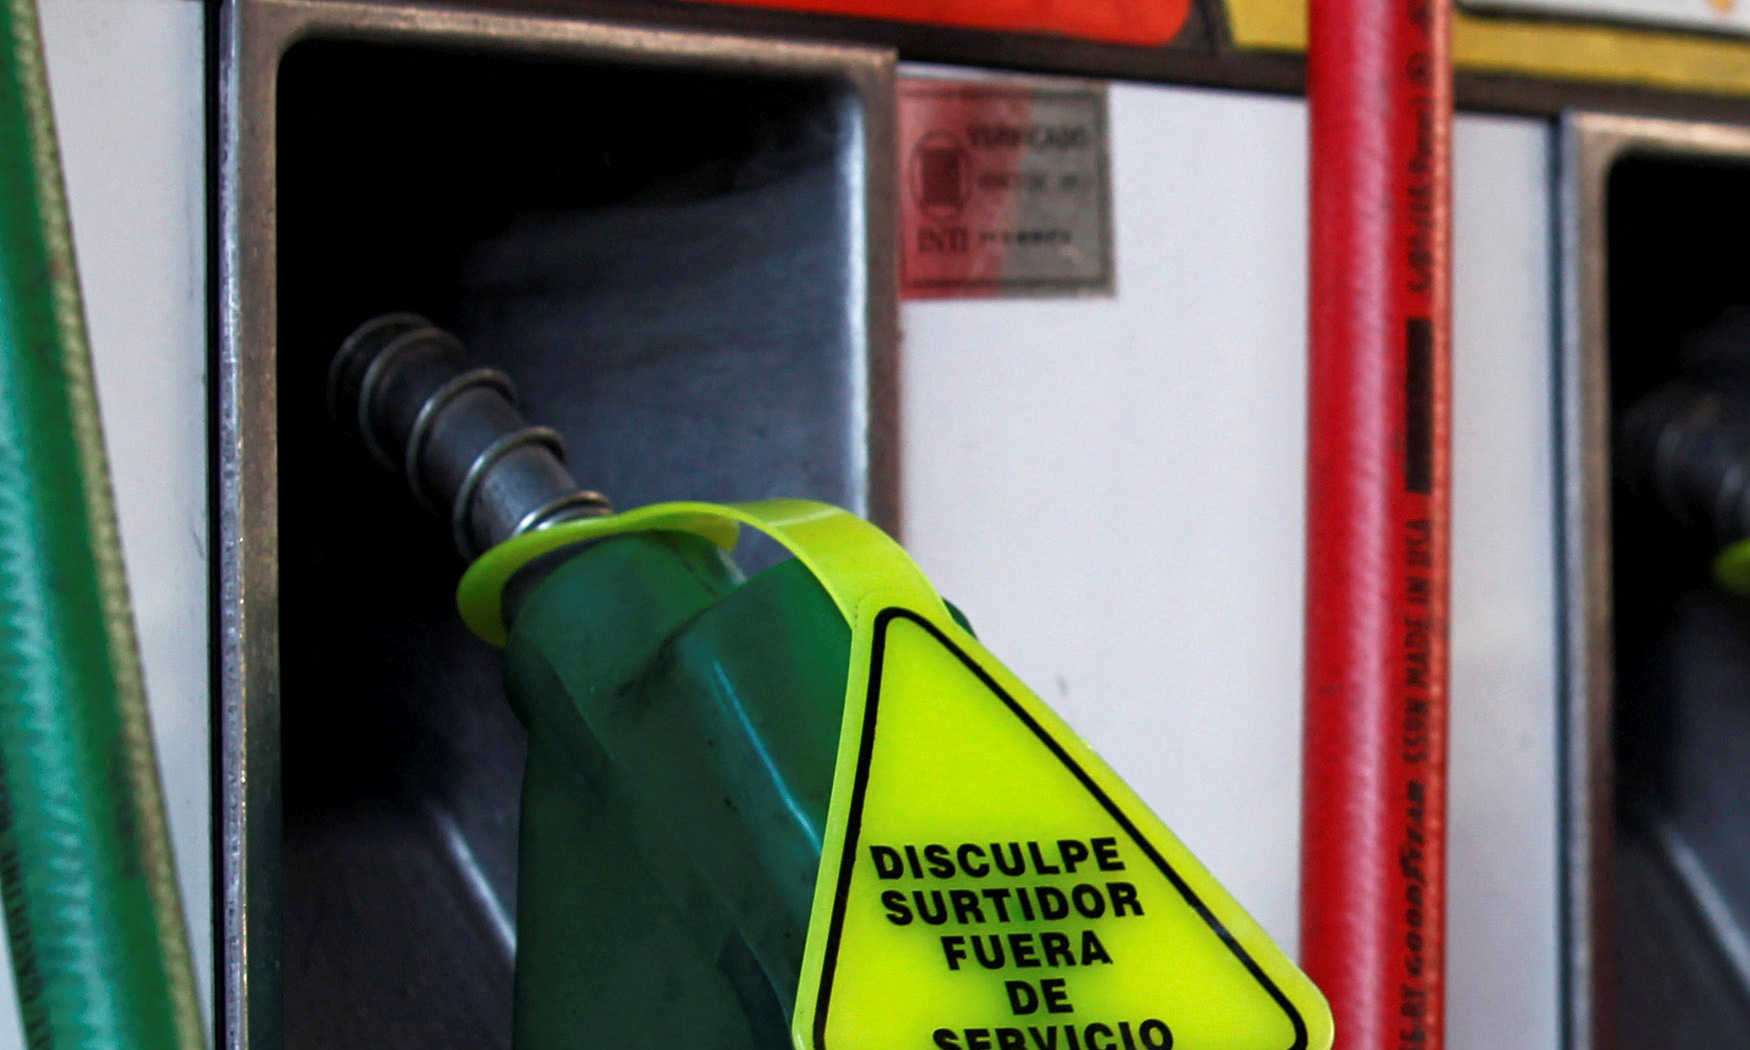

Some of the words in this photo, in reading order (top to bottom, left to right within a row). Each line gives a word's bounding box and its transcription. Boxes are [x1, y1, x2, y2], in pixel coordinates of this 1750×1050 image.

[1405, 517, 1433, 568] USA
[1405, 576, 1431, 604] IN
[1404, 614, 1431, 690] MADE
[870, 836, 1126, 881] DISCULPE
[881, 881, 1144, 926] SURTIDOR
[941, 930, 1114, 971] FUERA
[1005, 978, 1074, 1016] DE
[1400, 983, 1427, 1018] BY
